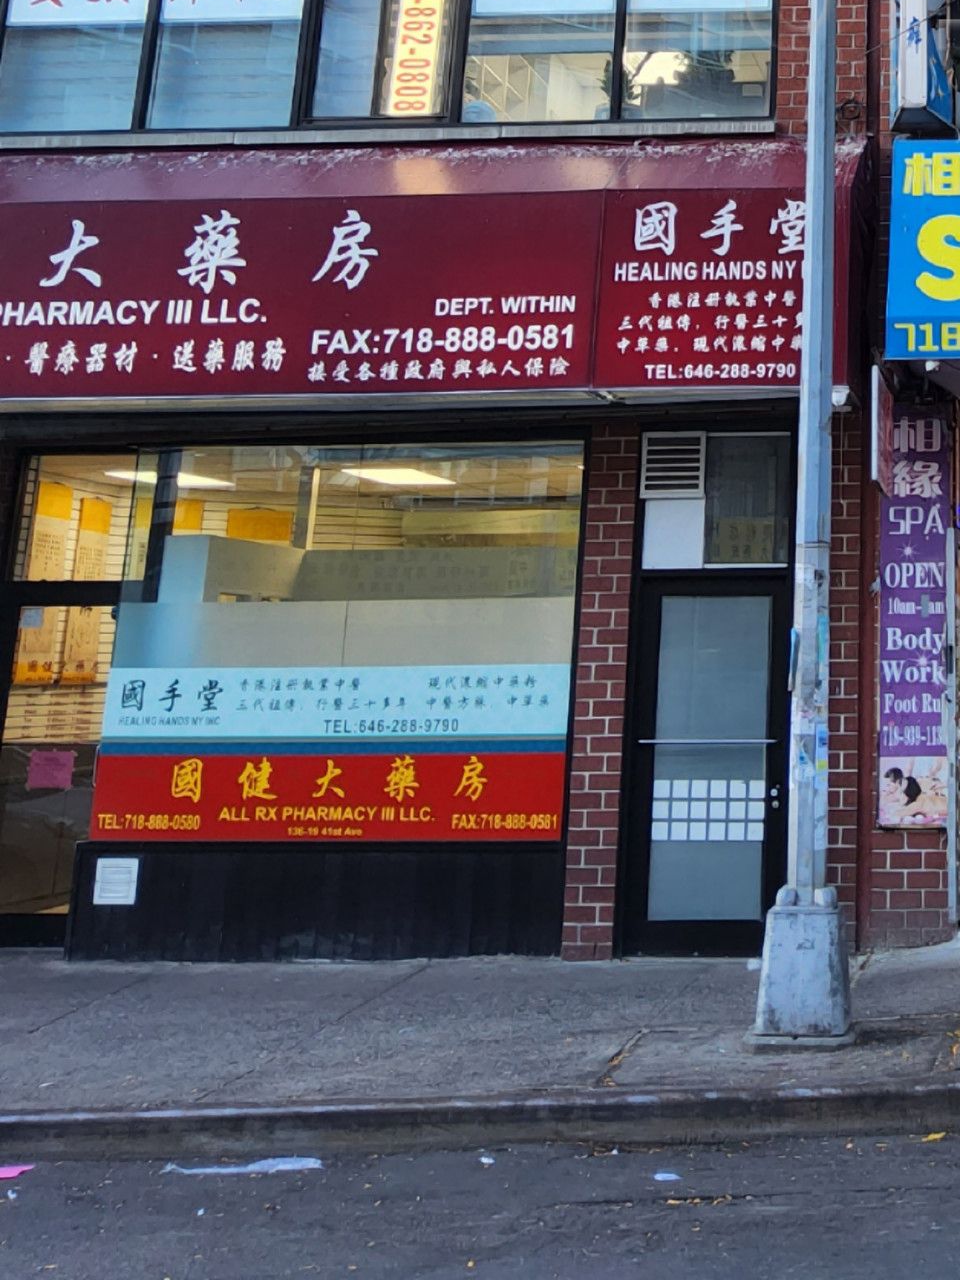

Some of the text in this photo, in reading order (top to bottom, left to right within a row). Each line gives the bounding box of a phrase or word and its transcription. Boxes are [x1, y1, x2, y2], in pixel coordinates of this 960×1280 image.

[634, 198, 806, 256] 國手堂
[39, 209, 379, 294] 大藥房
[614, 262, 697, 282] HEALING
[702, 261, 766, 281] HANDS
[772, 260, 796, 279] NY
[0, 298, 267, 326] HARMACY III LLC.
[435, 295, 576, 316] DEPT. WITHIN
[311, 324, 574, 354] FAX:718-888-0581
[645, 363, 796, 380] TEL:646-288-9790
[889, 506, 945, 535] SPA
[885, 562, 945, 589] OPEN
[888, 597, 945, 616] 10am-am
[886, 627, 944, 654] Body
[881, 659, 946, 684] Work
[121, 679, 224, 712] 國手堂
[883, 693, 943, 714] Foot Ru
[119, 716, 220, 726] HEALING HANDS NY INC
[324, 719, 459, 733] TEL:646-288-9790
[882, 725, 945, 748] 718-939-113
[171, 754, 488, 803] 國健大藥房
[98, 814, 200, 830] TEL:718-888-0580
[219, 806, 435, 821] ALL RX PHARMACY III LLC.
[452, 814, 557, 830] FAX:718-888-0581
